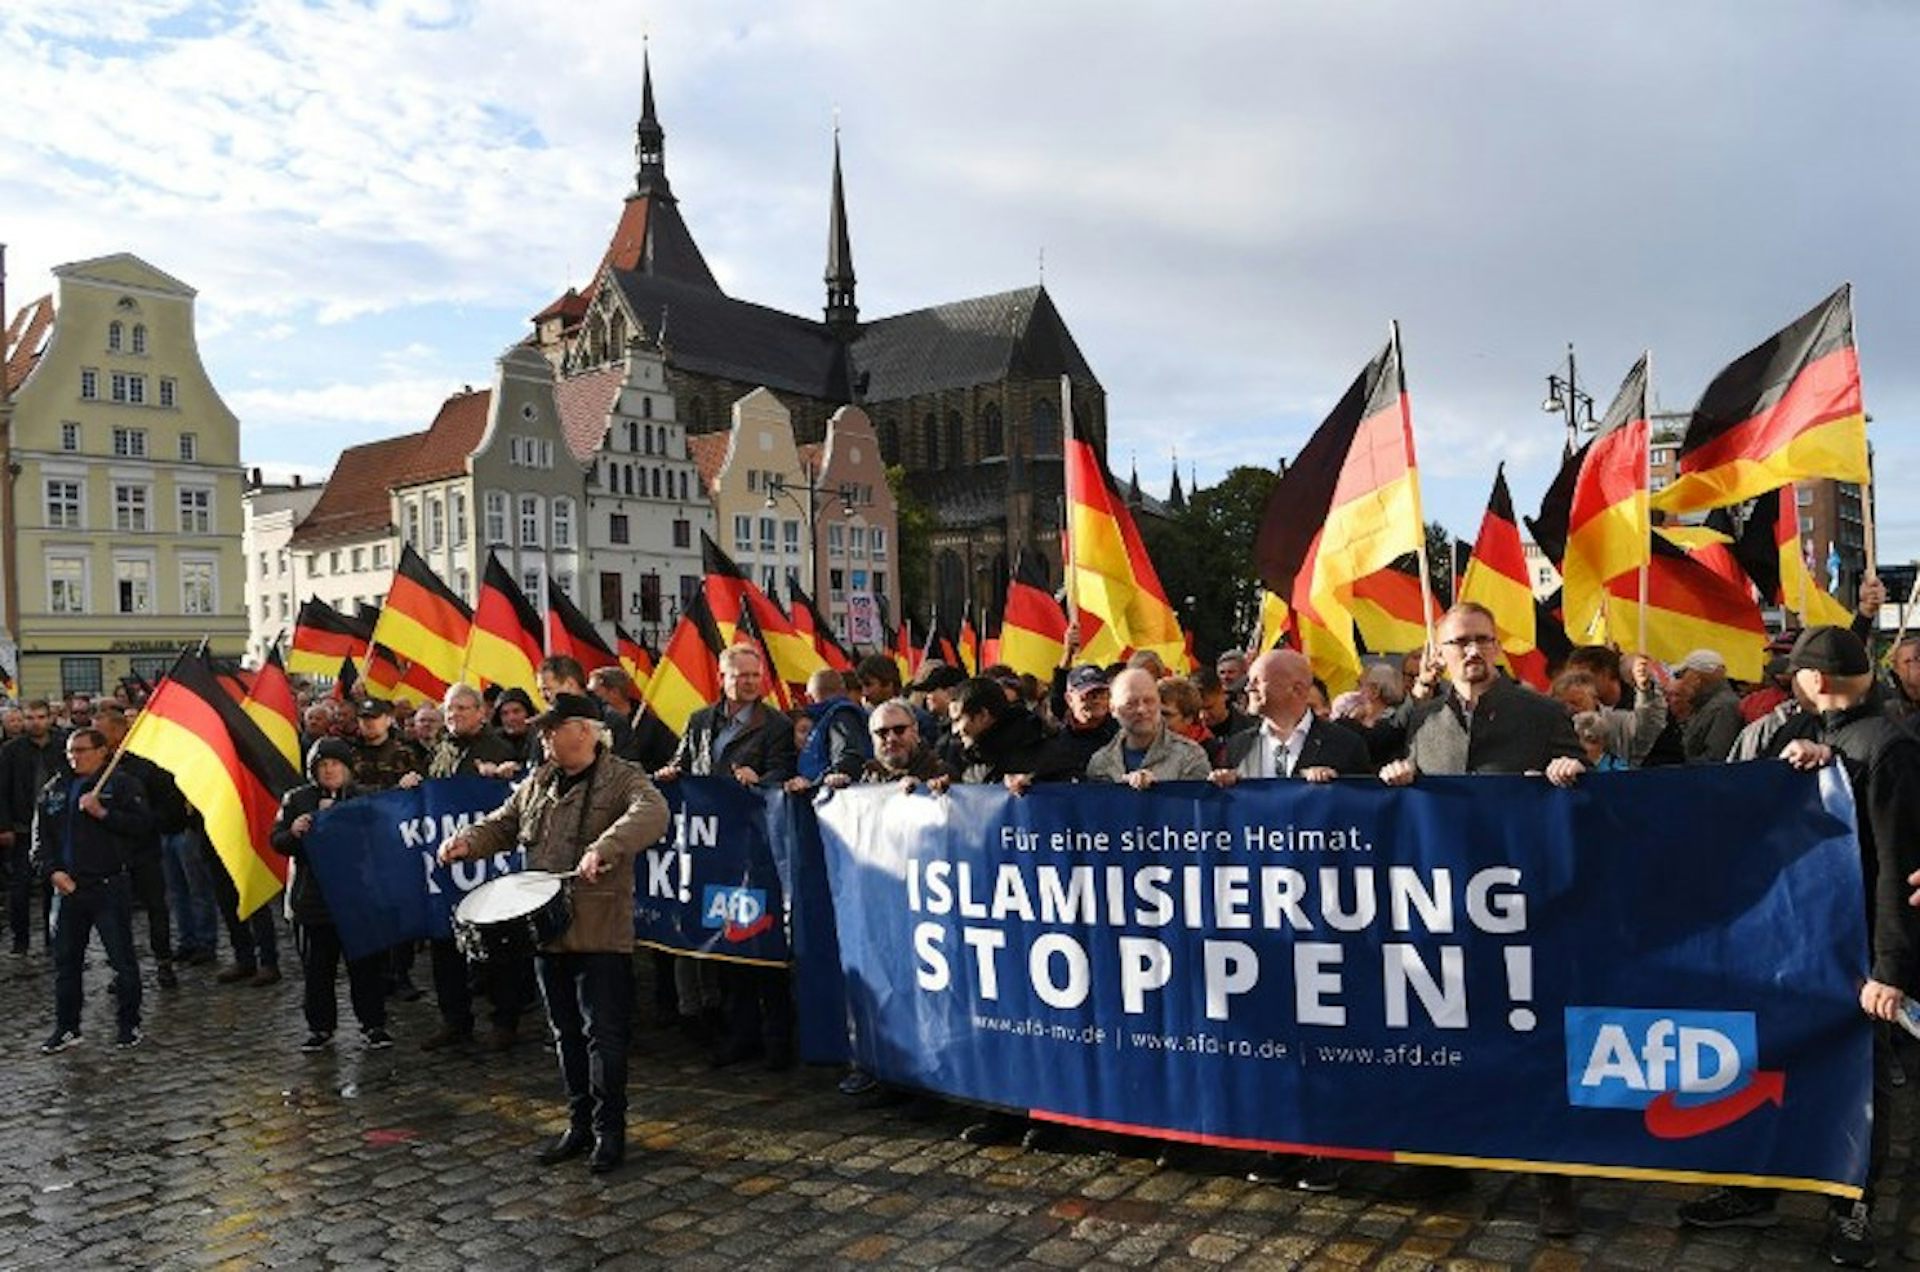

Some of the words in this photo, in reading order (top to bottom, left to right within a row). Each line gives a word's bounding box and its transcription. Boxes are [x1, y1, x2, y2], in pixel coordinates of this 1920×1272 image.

[1000, 826, 1040, 852] Für
[1050, 828, 1110, 852] eine
[1121, 826, 1232, 852] sichere
[1244, 826, 1373, 852] Heimat.
[707, 888, 760, 925] AfD
[907, 857, 1528, 935] ISLAMISIERUNG
[914, 922, 1538, 1032] STOPPEN!
[1131, 1031, 1287, 1059] www.afd-ro.de
[1318, 1044, 1462, 1067] www.afd.de
[1581, 1018, 1741, 1093] AfD
